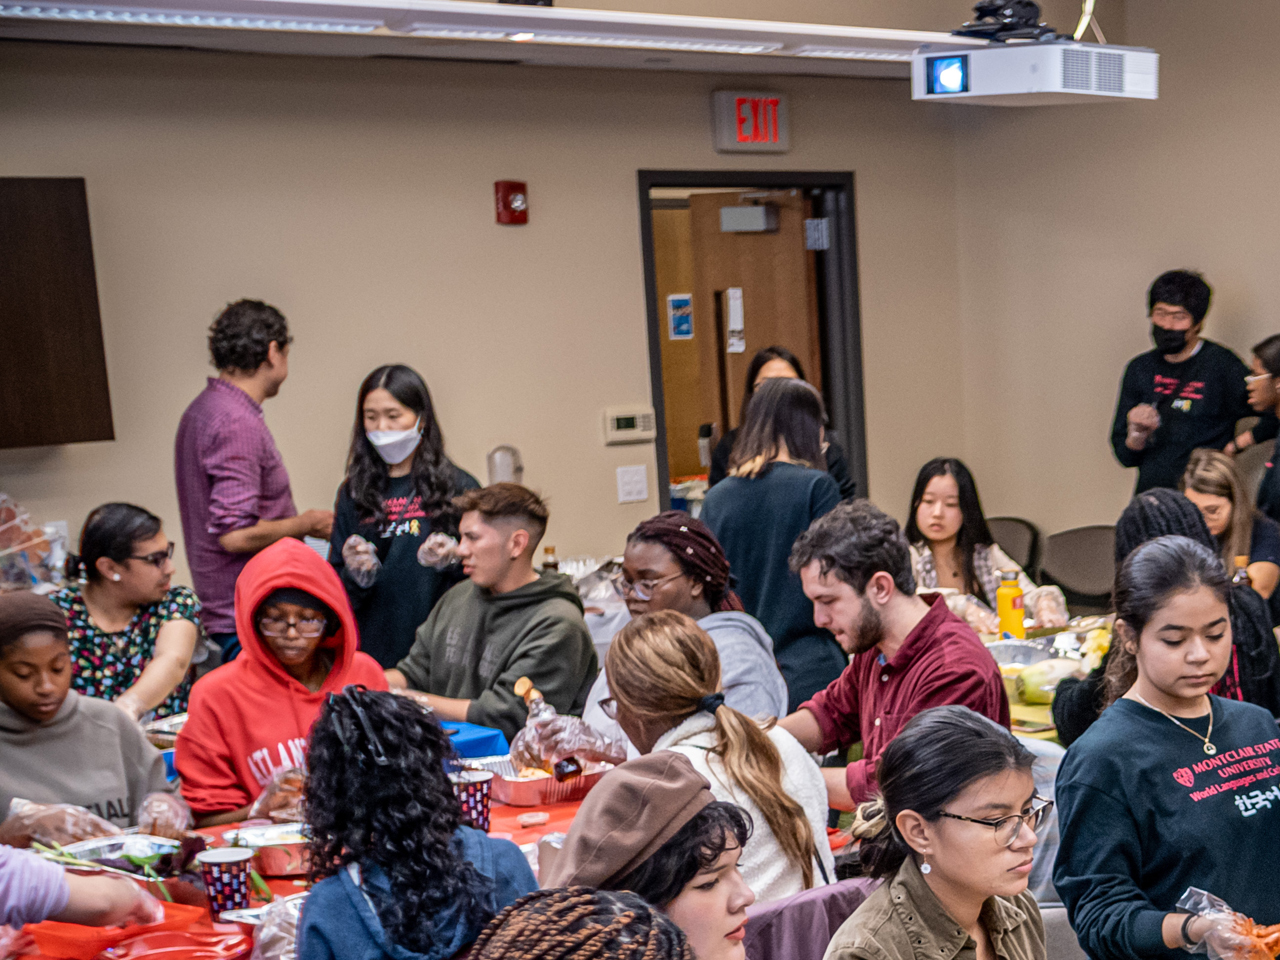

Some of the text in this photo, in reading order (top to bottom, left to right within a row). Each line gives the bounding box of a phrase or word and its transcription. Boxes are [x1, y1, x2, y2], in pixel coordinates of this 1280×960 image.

[735, 97, 780, 143] EXIT
[1192, 746, 1256, 775] MONTCLAIR
[1217, 756, 1272, 778] UNIVERSITY
[1189, 784, 1218, 802] World
[1215, 774, 1257, 791] Languages
[1255, 768, 1270, 780] and
